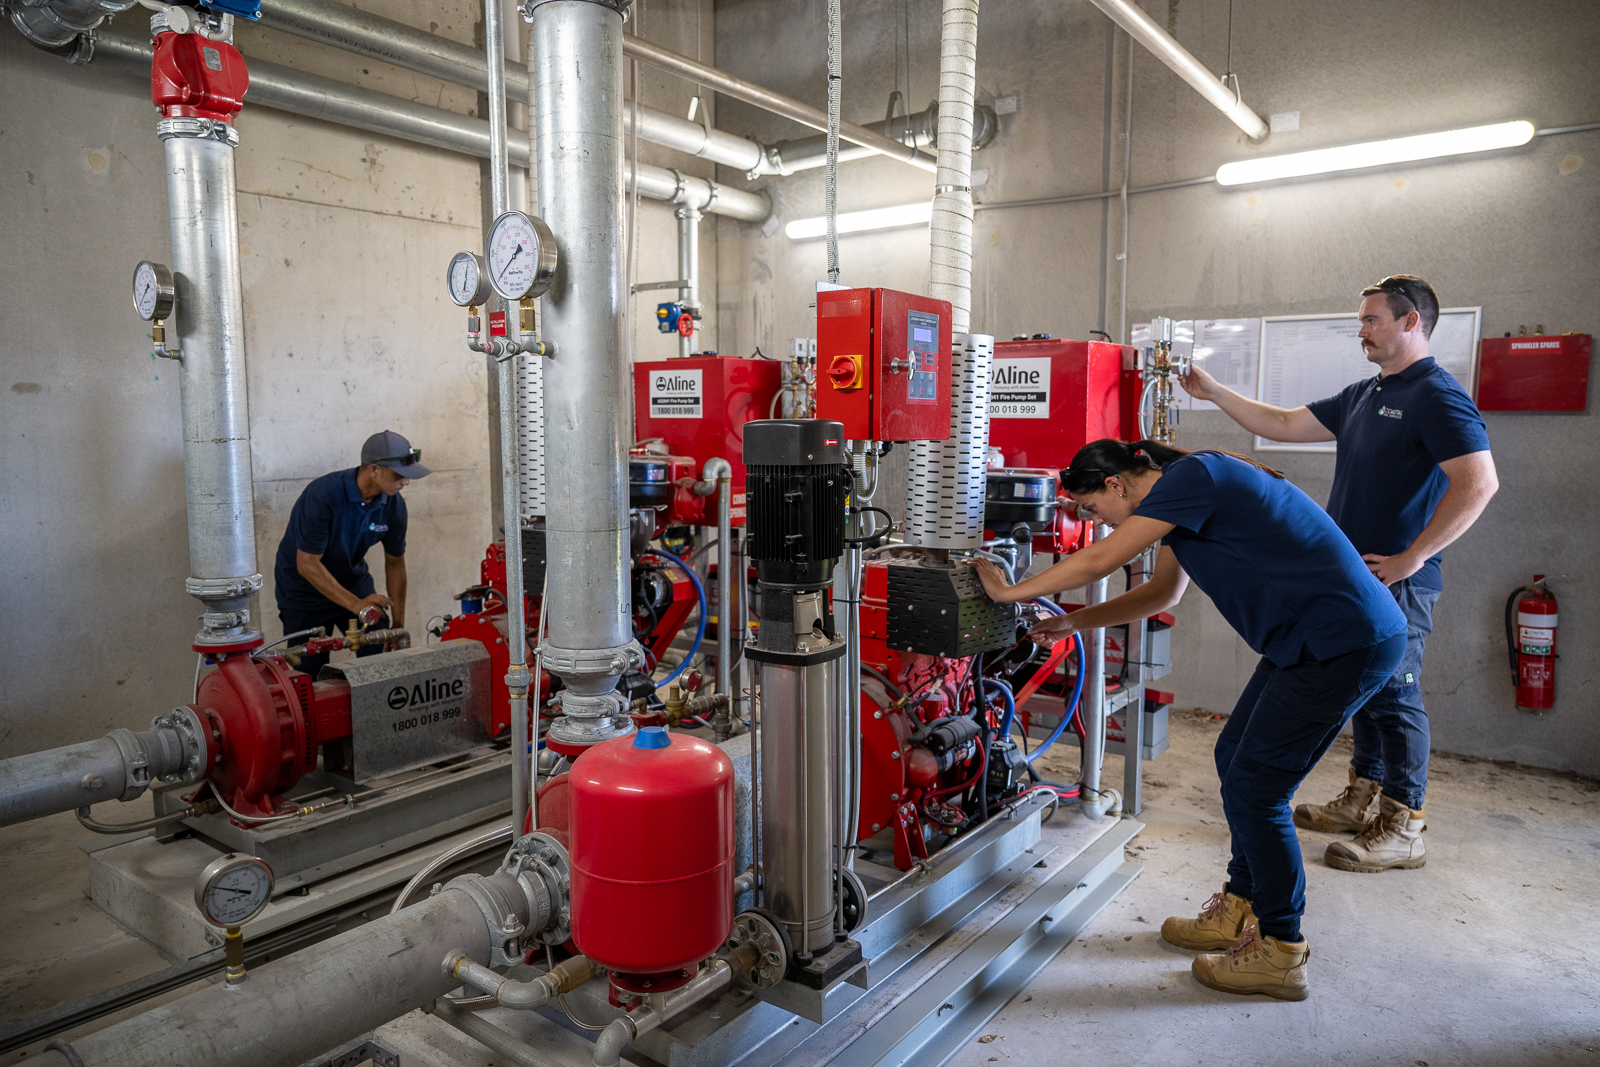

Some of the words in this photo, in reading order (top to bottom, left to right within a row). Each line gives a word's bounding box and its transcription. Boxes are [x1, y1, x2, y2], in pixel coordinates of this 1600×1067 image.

[666, 376, 696, 391] Aline
[995, 366, 1040, 384] Aline
[410, 678, 463, 706] Aline
[392, 718, 418, 732] 1800
[421, 712, 439, 725] 018
[442, 707, 460, 720] 999
